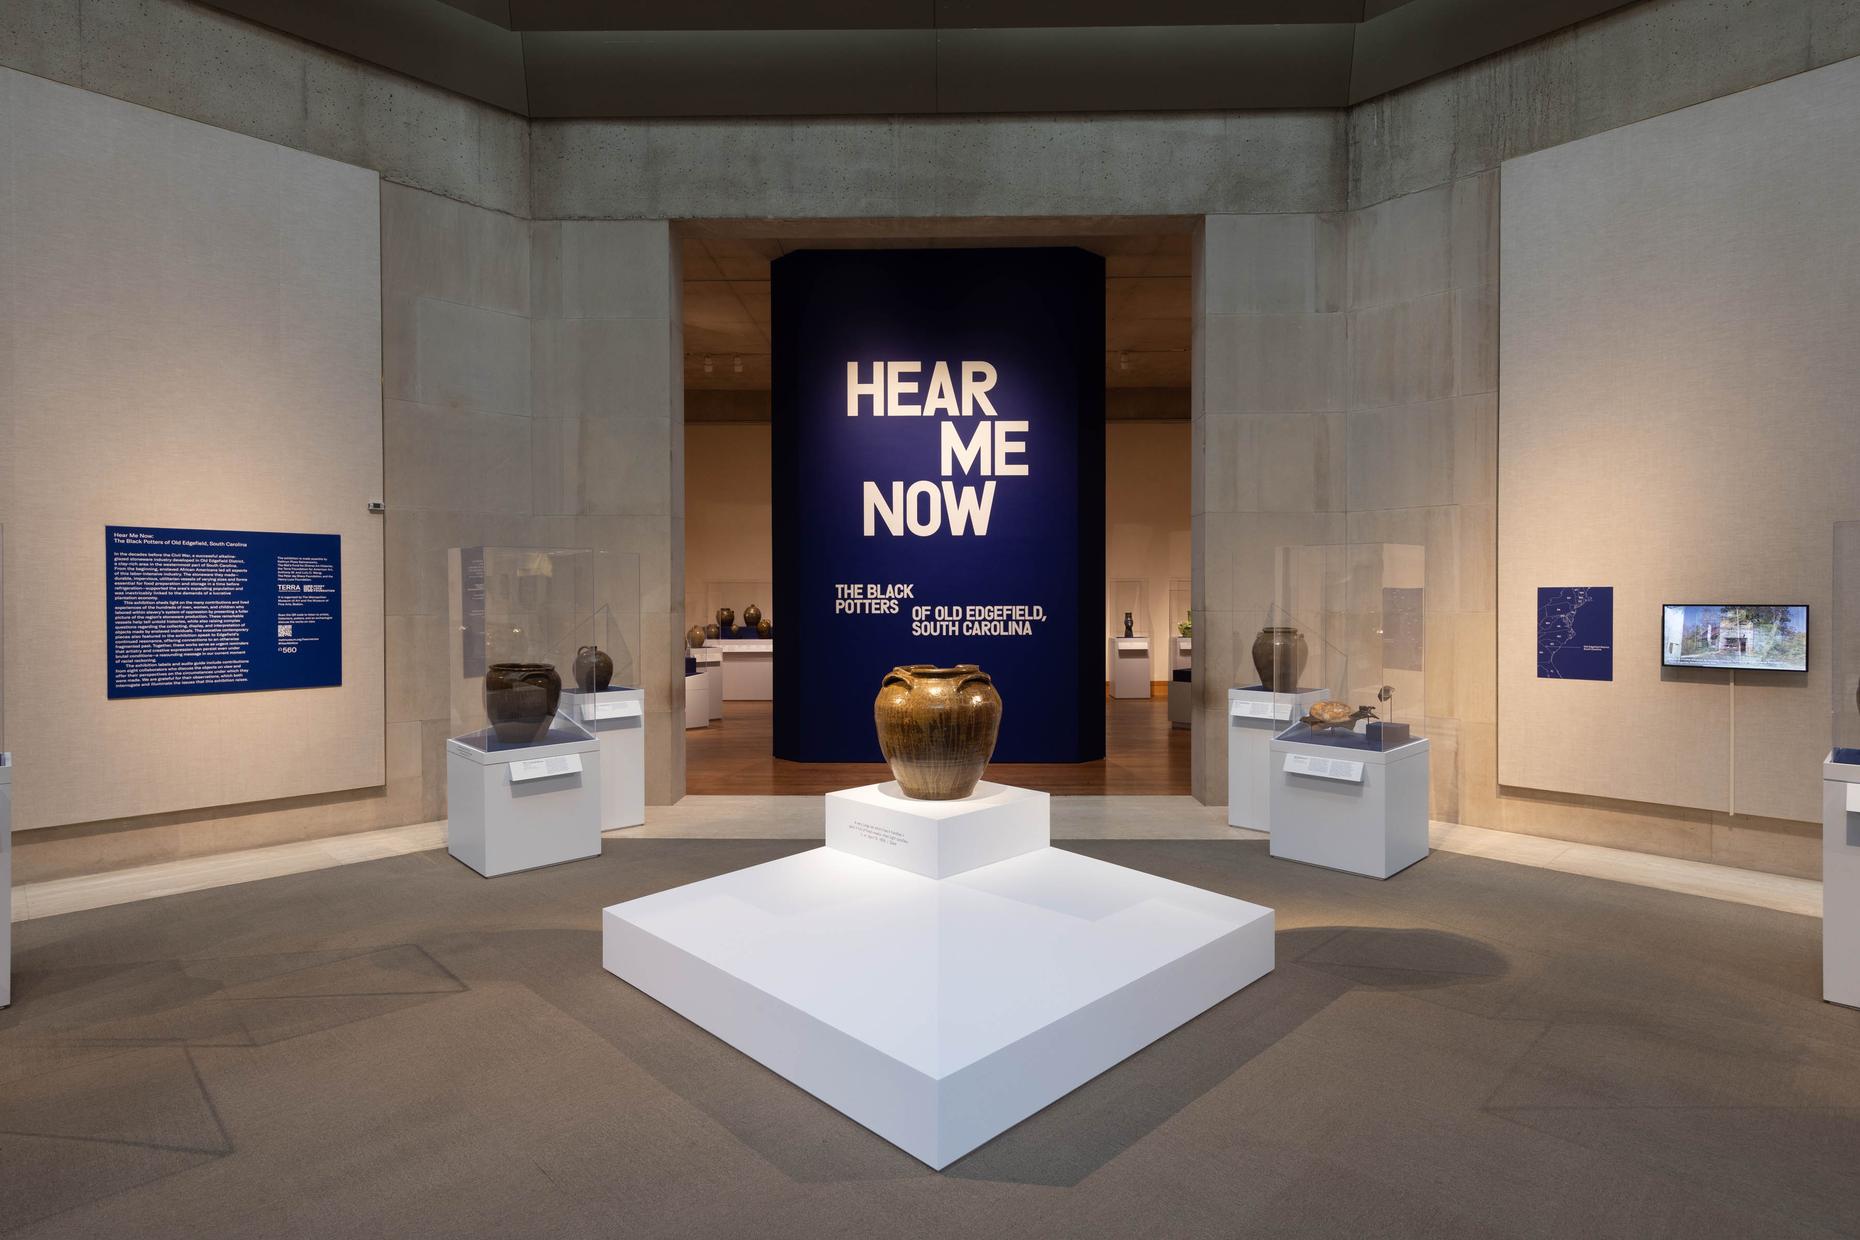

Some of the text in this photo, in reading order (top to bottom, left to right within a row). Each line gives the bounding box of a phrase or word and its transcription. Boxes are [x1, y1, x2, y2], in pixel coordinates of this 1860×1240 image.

[847, 361, 998, 416] HEAR
[941, 420, 1029, 476] ME
[863, 480, 997, 537] NOW
[835, 584, 914, 599] THE BLACK
[835, 600, 899, 614] POTTERS
[912, 605, 1047, 622] OF OLD EDGEFIELD,
[912, 621, 1032, 636] SOUTH CAROLINA
